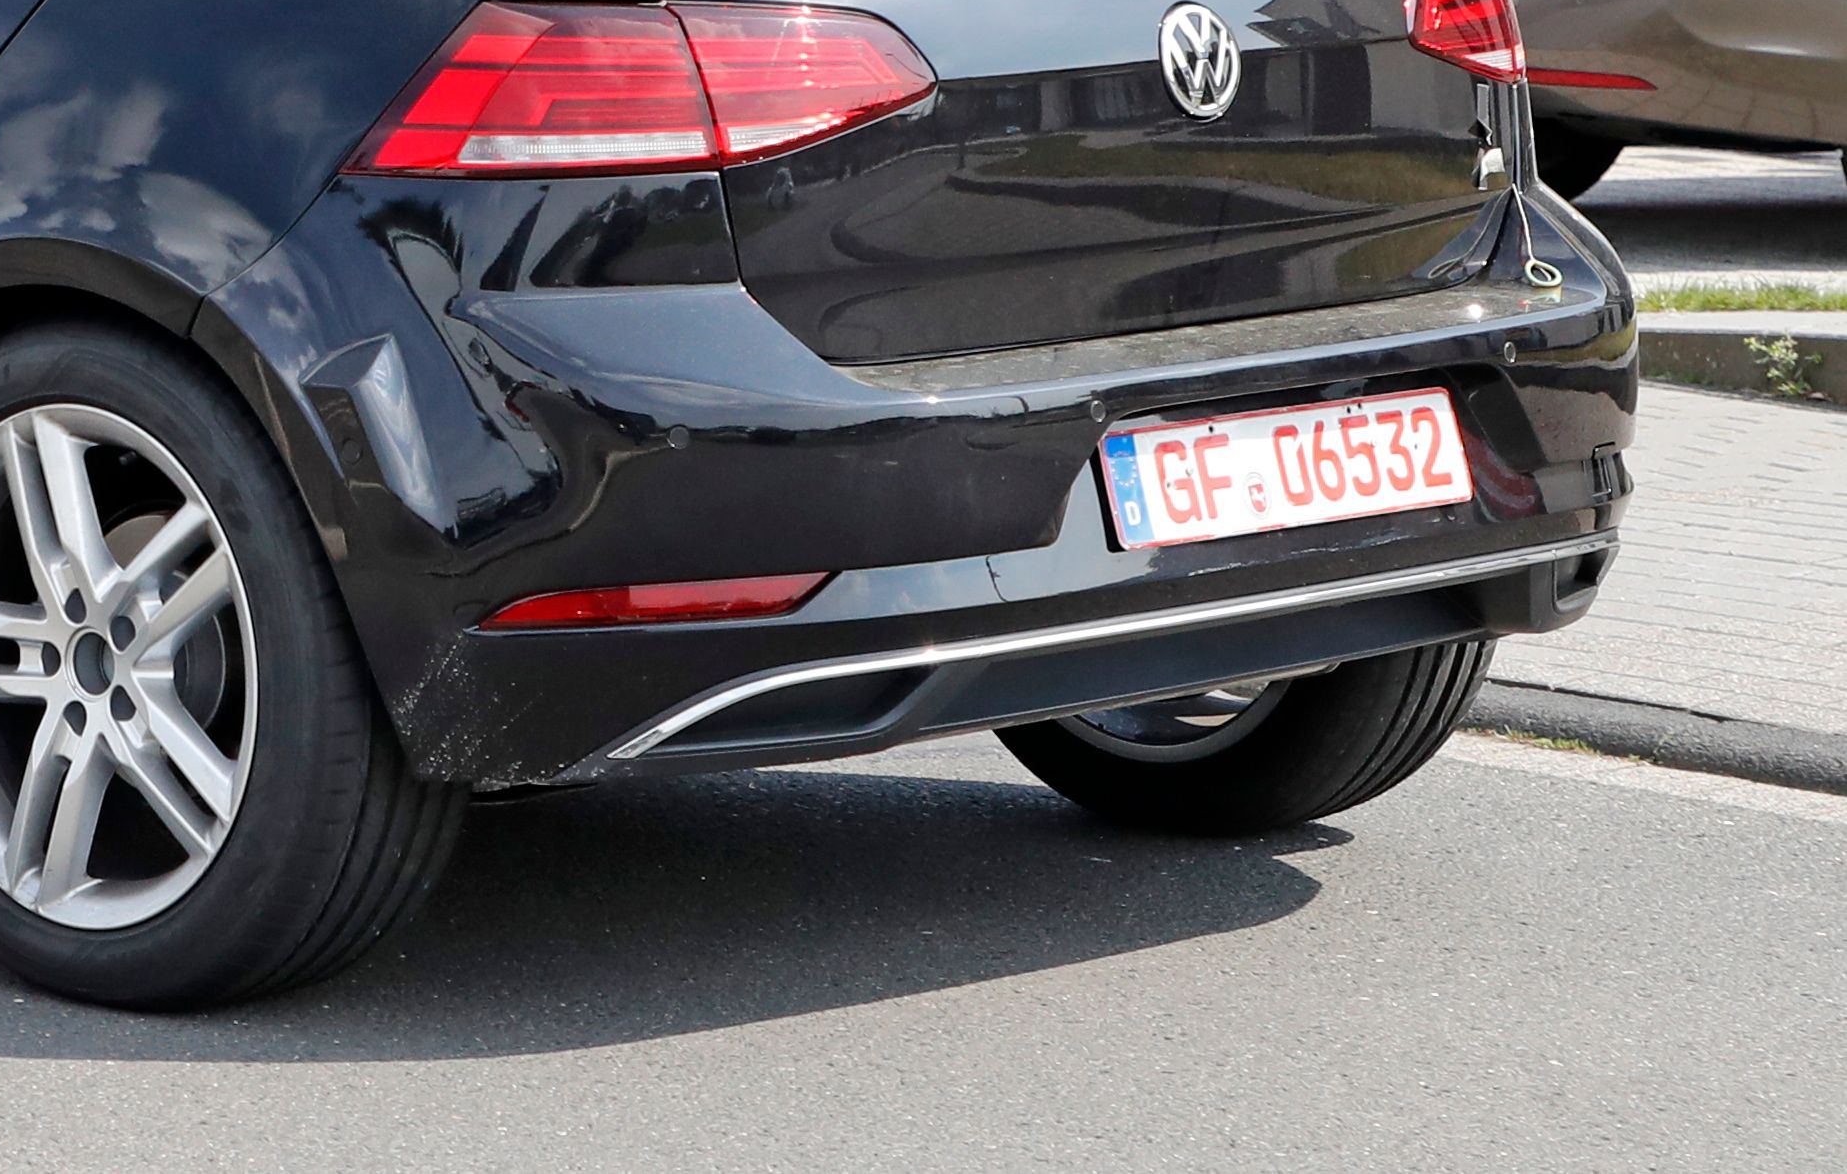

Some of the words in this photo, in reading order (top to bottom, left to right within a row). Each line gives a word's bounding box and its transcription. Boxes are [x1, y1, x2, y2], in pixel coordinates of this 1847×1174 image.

[1124, 500, 1142, 526] D
[1153, 433, 1233, 524] GF
[1272, 406, 1453, 507] 06532
